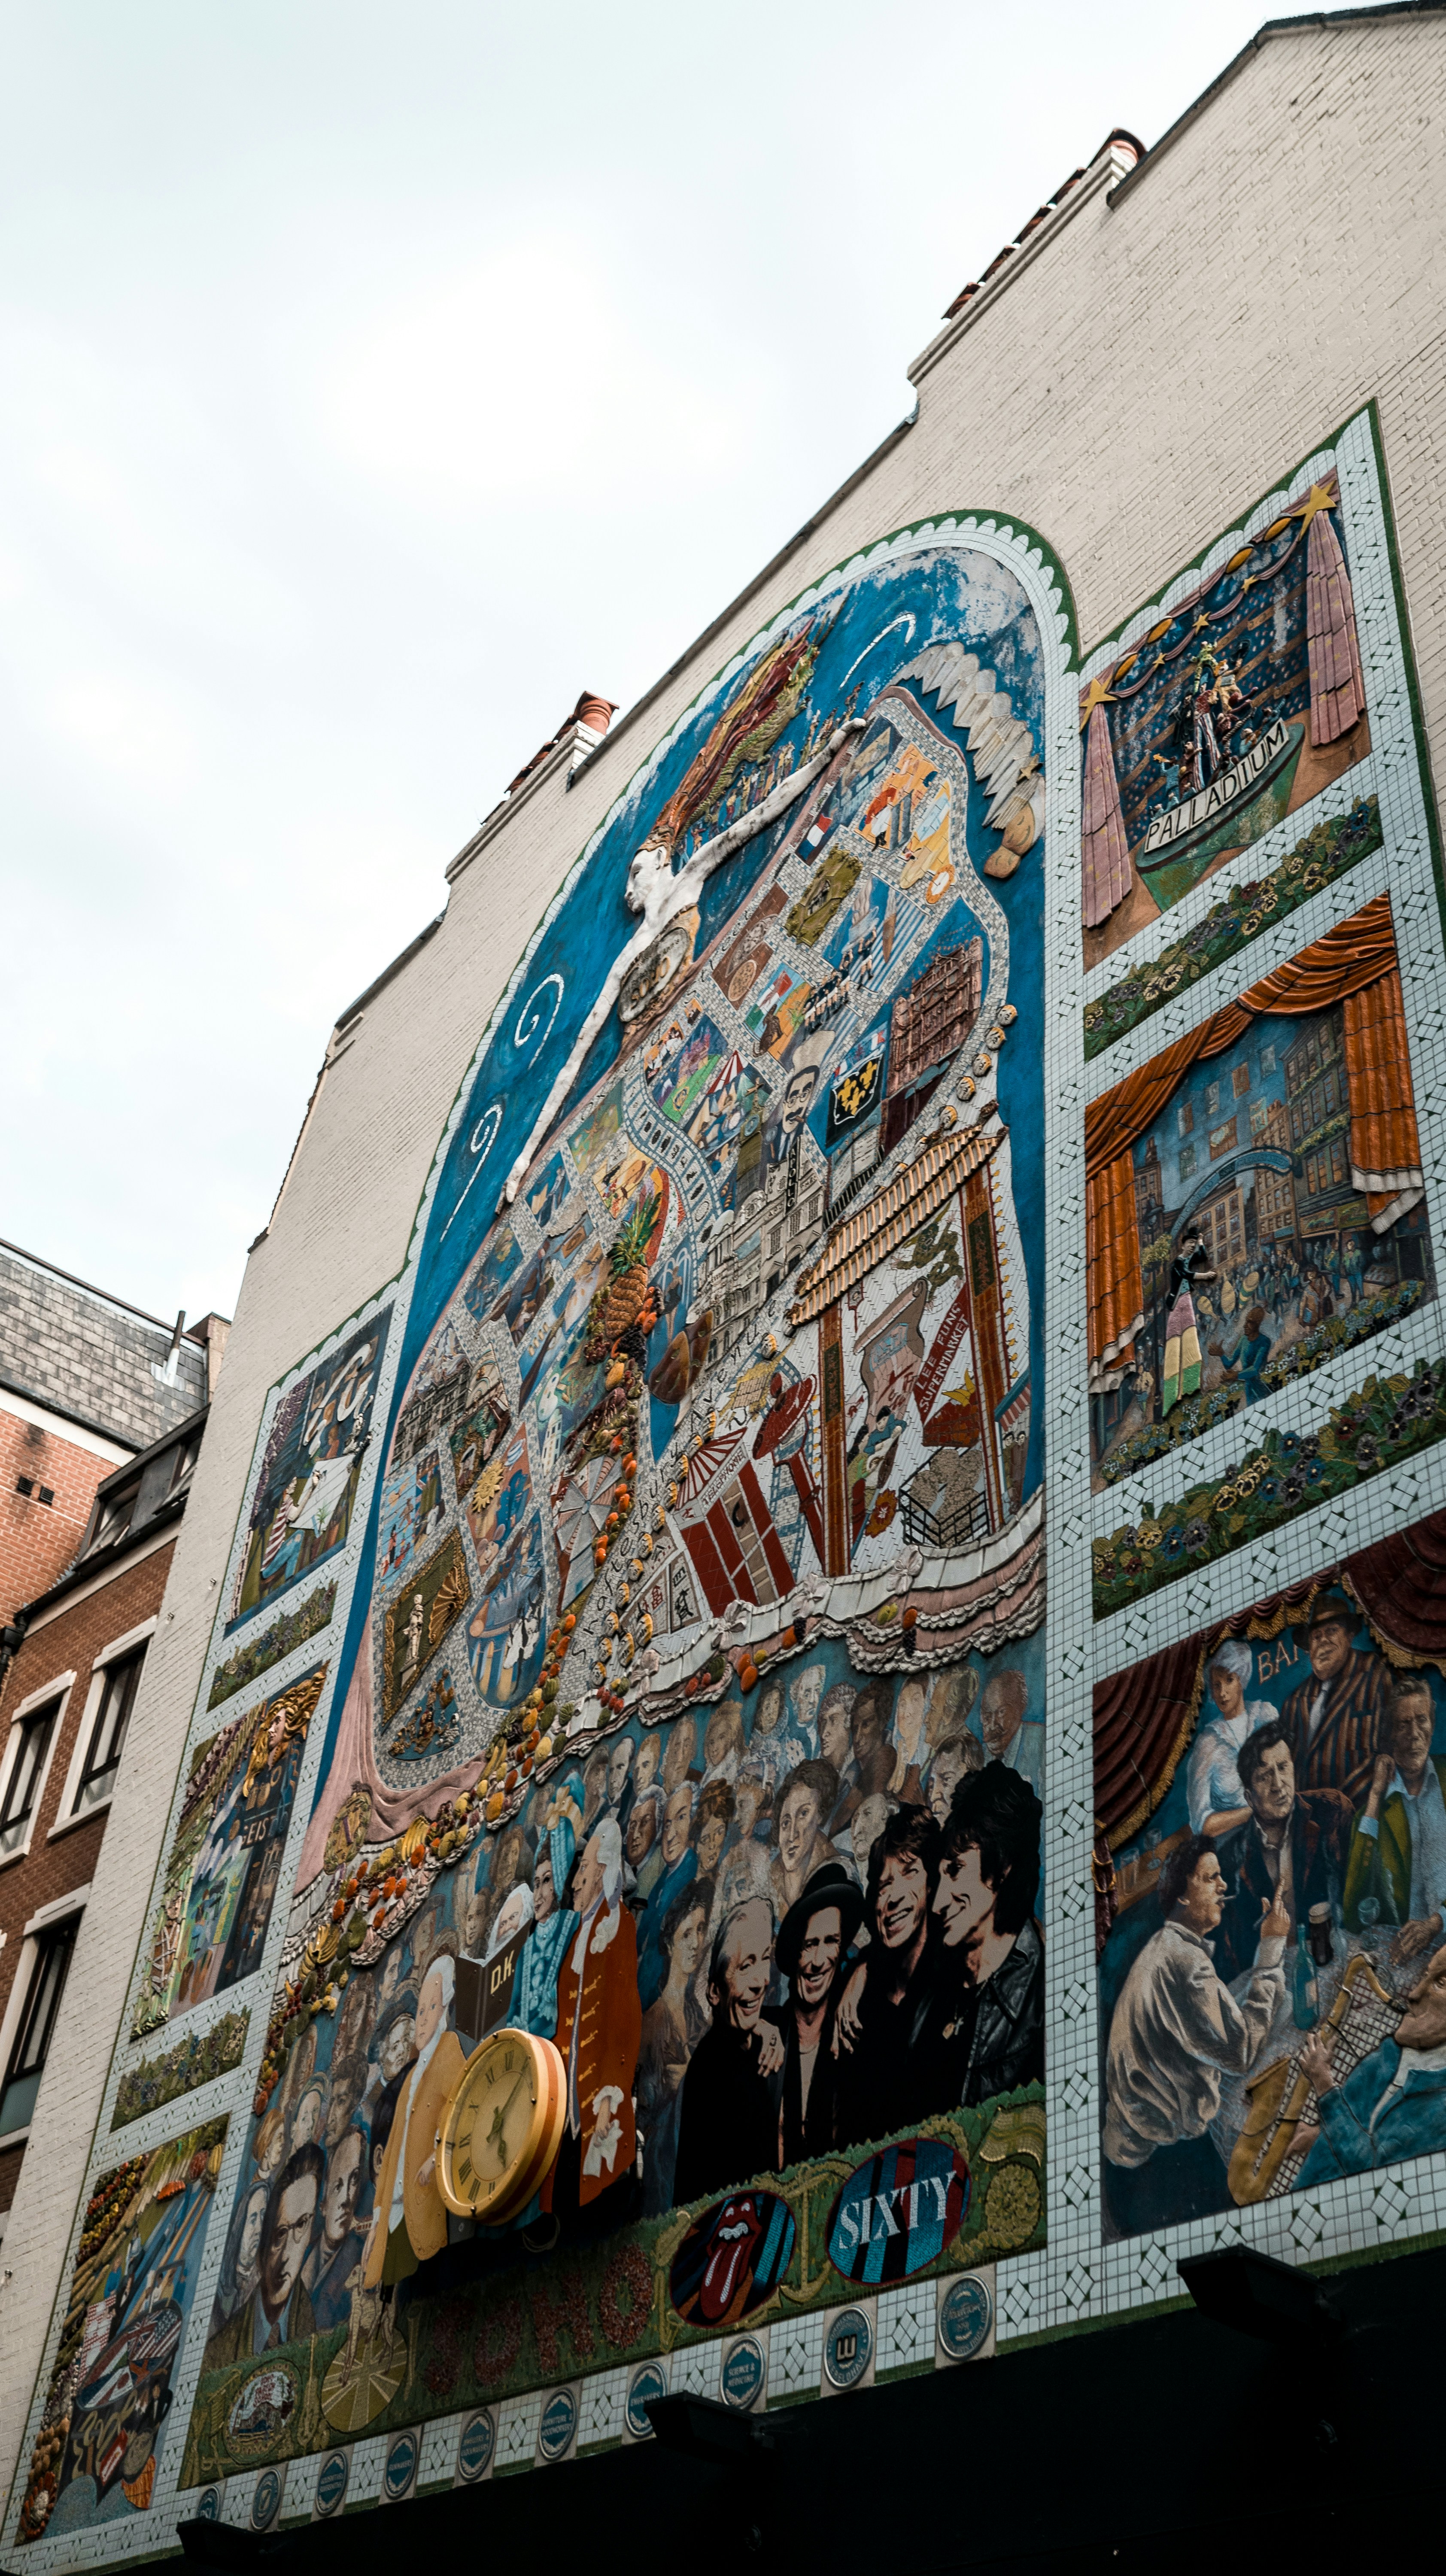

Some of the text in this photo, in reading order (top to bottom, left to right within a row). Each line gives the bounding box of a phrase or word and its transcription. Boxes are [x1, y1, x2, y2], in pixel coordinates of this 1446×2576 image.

[1147, 725, 1286, 849] PALLADIUM
[787, 1149, 796, 1208] APOLLO
[916, 1303, 961, 1389] LEE FUNG
[920, 1314, 970, 1412] SUPERMARKET
[702, 1449, 746, 1505] TELEPHONE
[490, 1950, 515, 1995] D.K.
[838, 2170, 957, 2250] SIXTY
[425, 2243, 653, 2396] SOHO
[727, 2372, 754, 2388] MEDICINE
[728, 2361, 755, 2377] SCIENCE &
